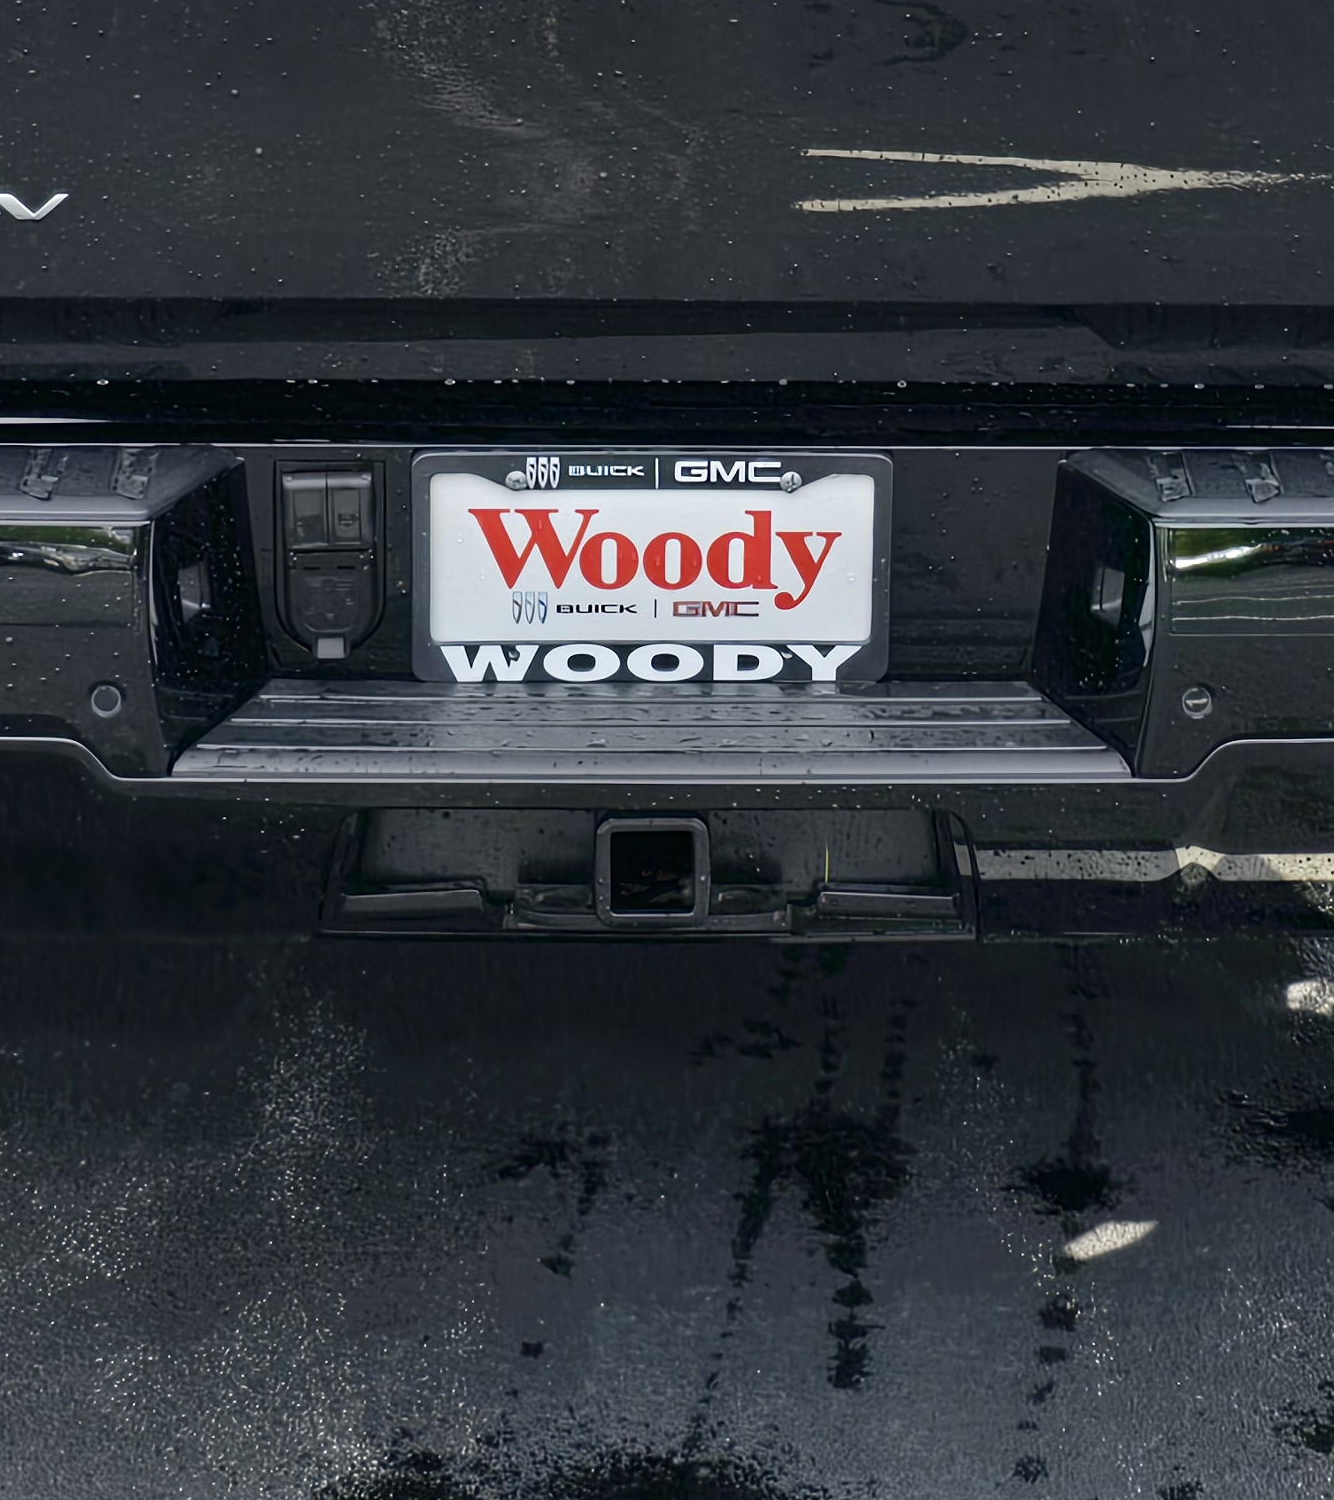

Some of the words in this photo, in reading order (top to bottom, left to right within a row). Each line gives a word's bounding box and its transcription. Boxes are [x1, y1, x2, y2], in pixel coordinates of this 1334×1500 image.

[568, 464, 645, 477] BUICK
[674, 460, 782, 483] GMC
[468, 508, 842, 610] Woody
[556, 603, 638, 614] BUICK
[673, 600, 760, 618] GMC
[440, 644, 866, 682] WOODY
